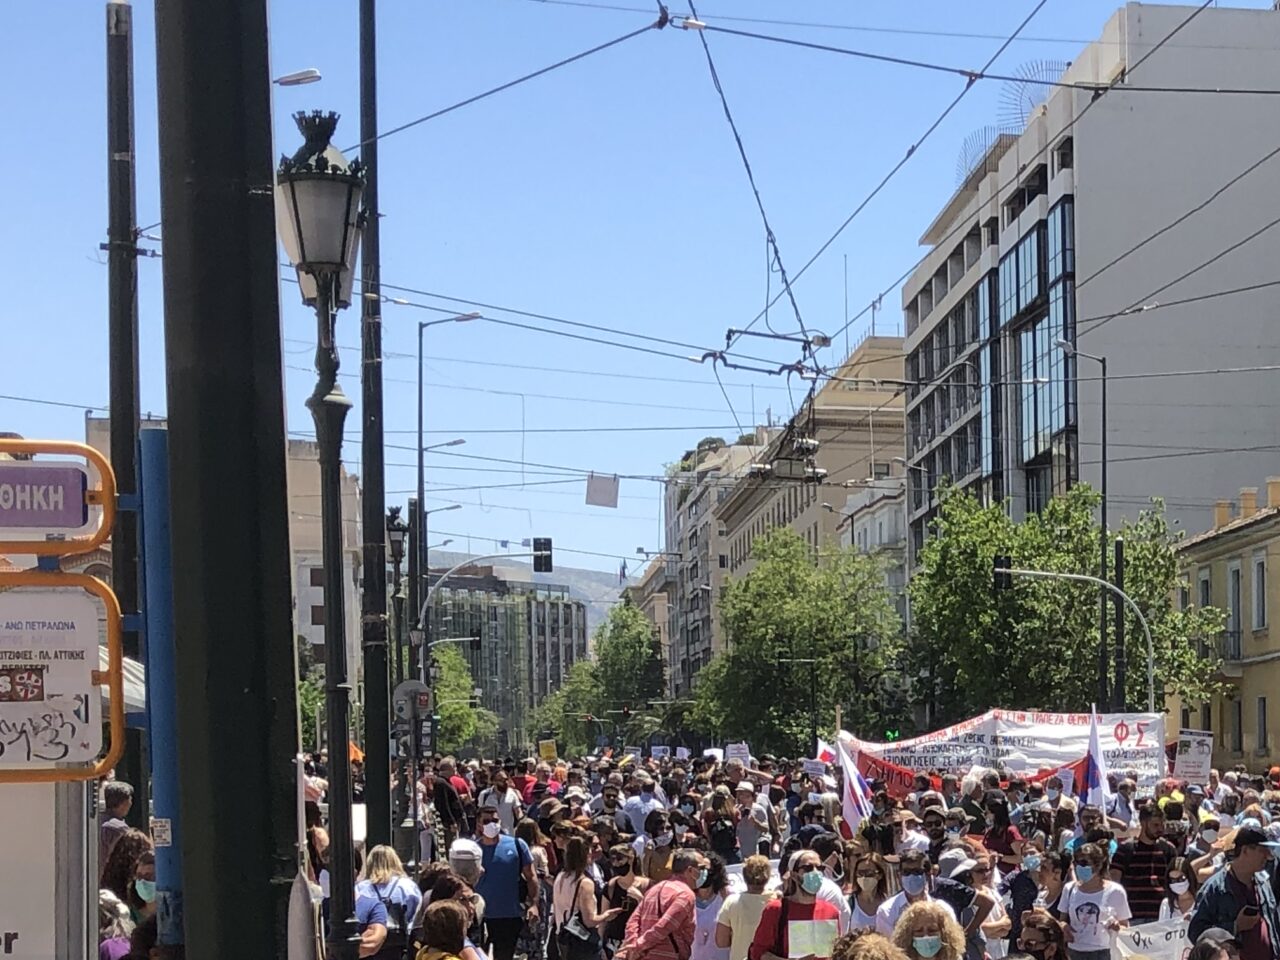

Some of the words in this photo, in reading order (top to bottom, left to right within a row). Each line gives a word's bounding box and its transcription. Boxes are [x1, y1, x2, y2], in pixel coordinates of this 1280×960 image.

[5, 621, 23, 630] ΑΝΩ
[25, 621, 76, 631] ΠΕΤΡΑΛΩΝΑ
[1067, 713, 1103, 726] ΘΕΜΑΤΝ
